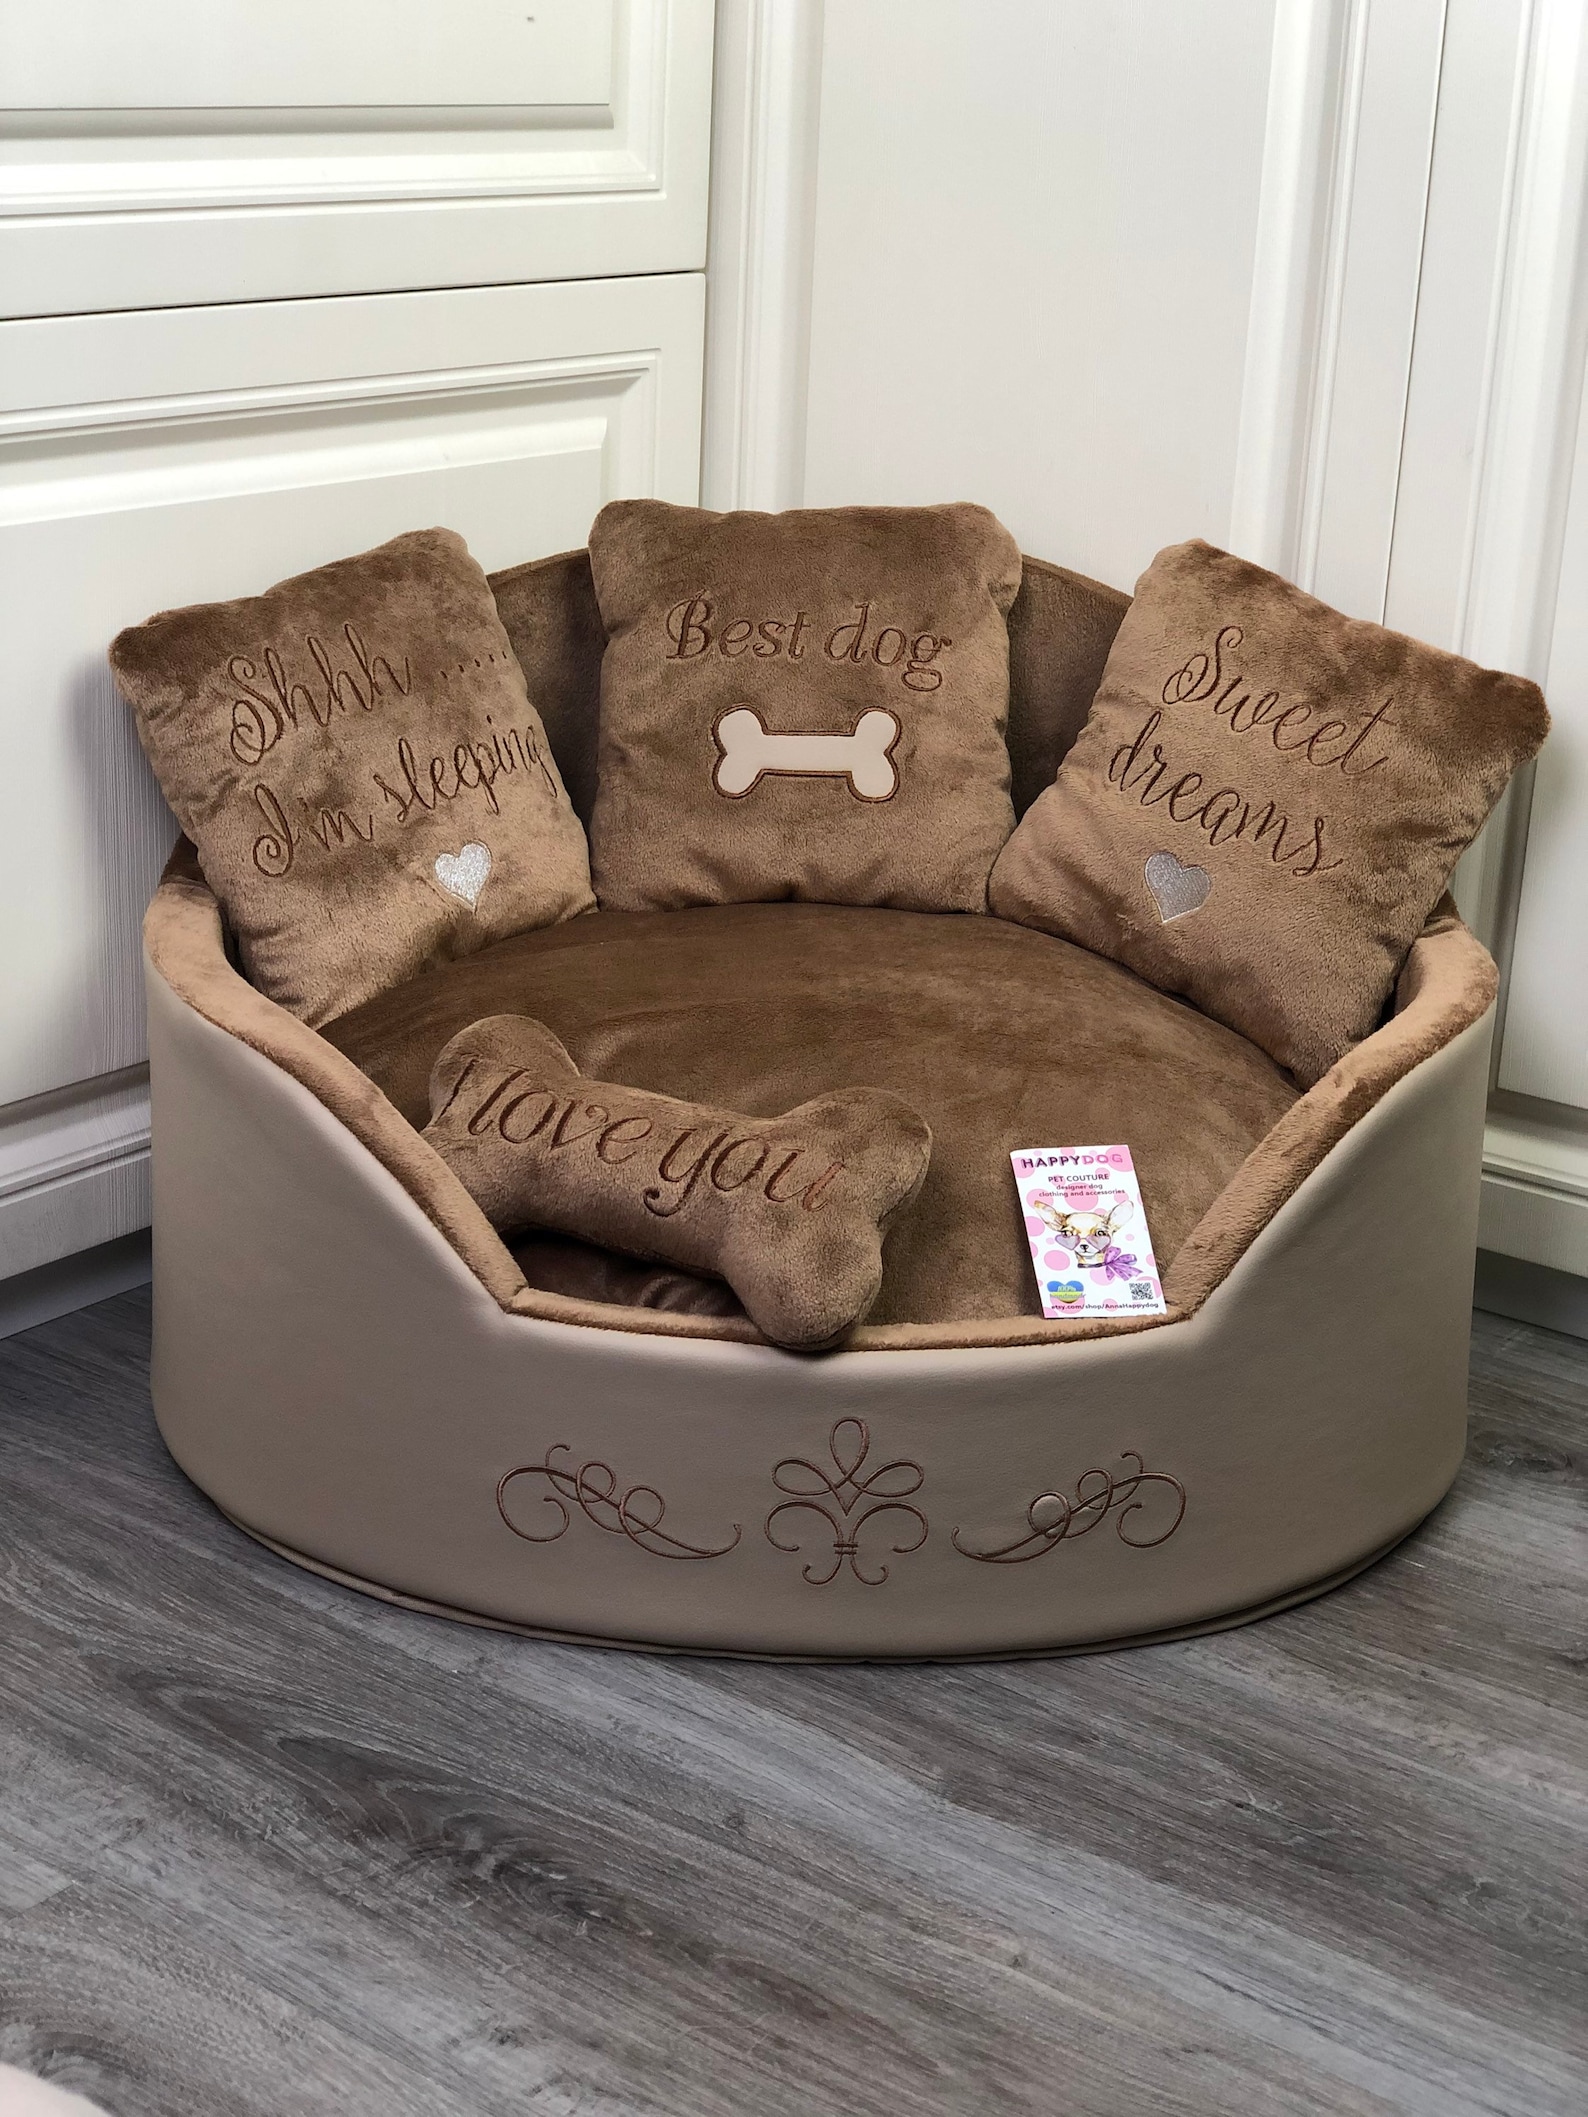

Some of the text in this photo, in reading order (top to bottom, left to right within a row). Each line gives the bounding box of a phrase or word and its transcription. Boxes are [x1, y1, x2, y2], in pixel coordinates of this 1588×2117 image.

[228, 622, 411, 766] Shhh
[666, 590, 952, 692] Best dog
[1161, 625, 1397, 775] Sweet
[372, 714, 558, 822] sleeping
[1108, 710, 1343, 878] dreams
[467, 1064, 653, 1165] love
[643, 1125, 846, 1218] you
[1020, 1153, 1124, 1169] HAPPYDOG
[1047, 1173, 1110, 1183] PET COUTURE
[1085, 1188, 1126, 1196] accessories
